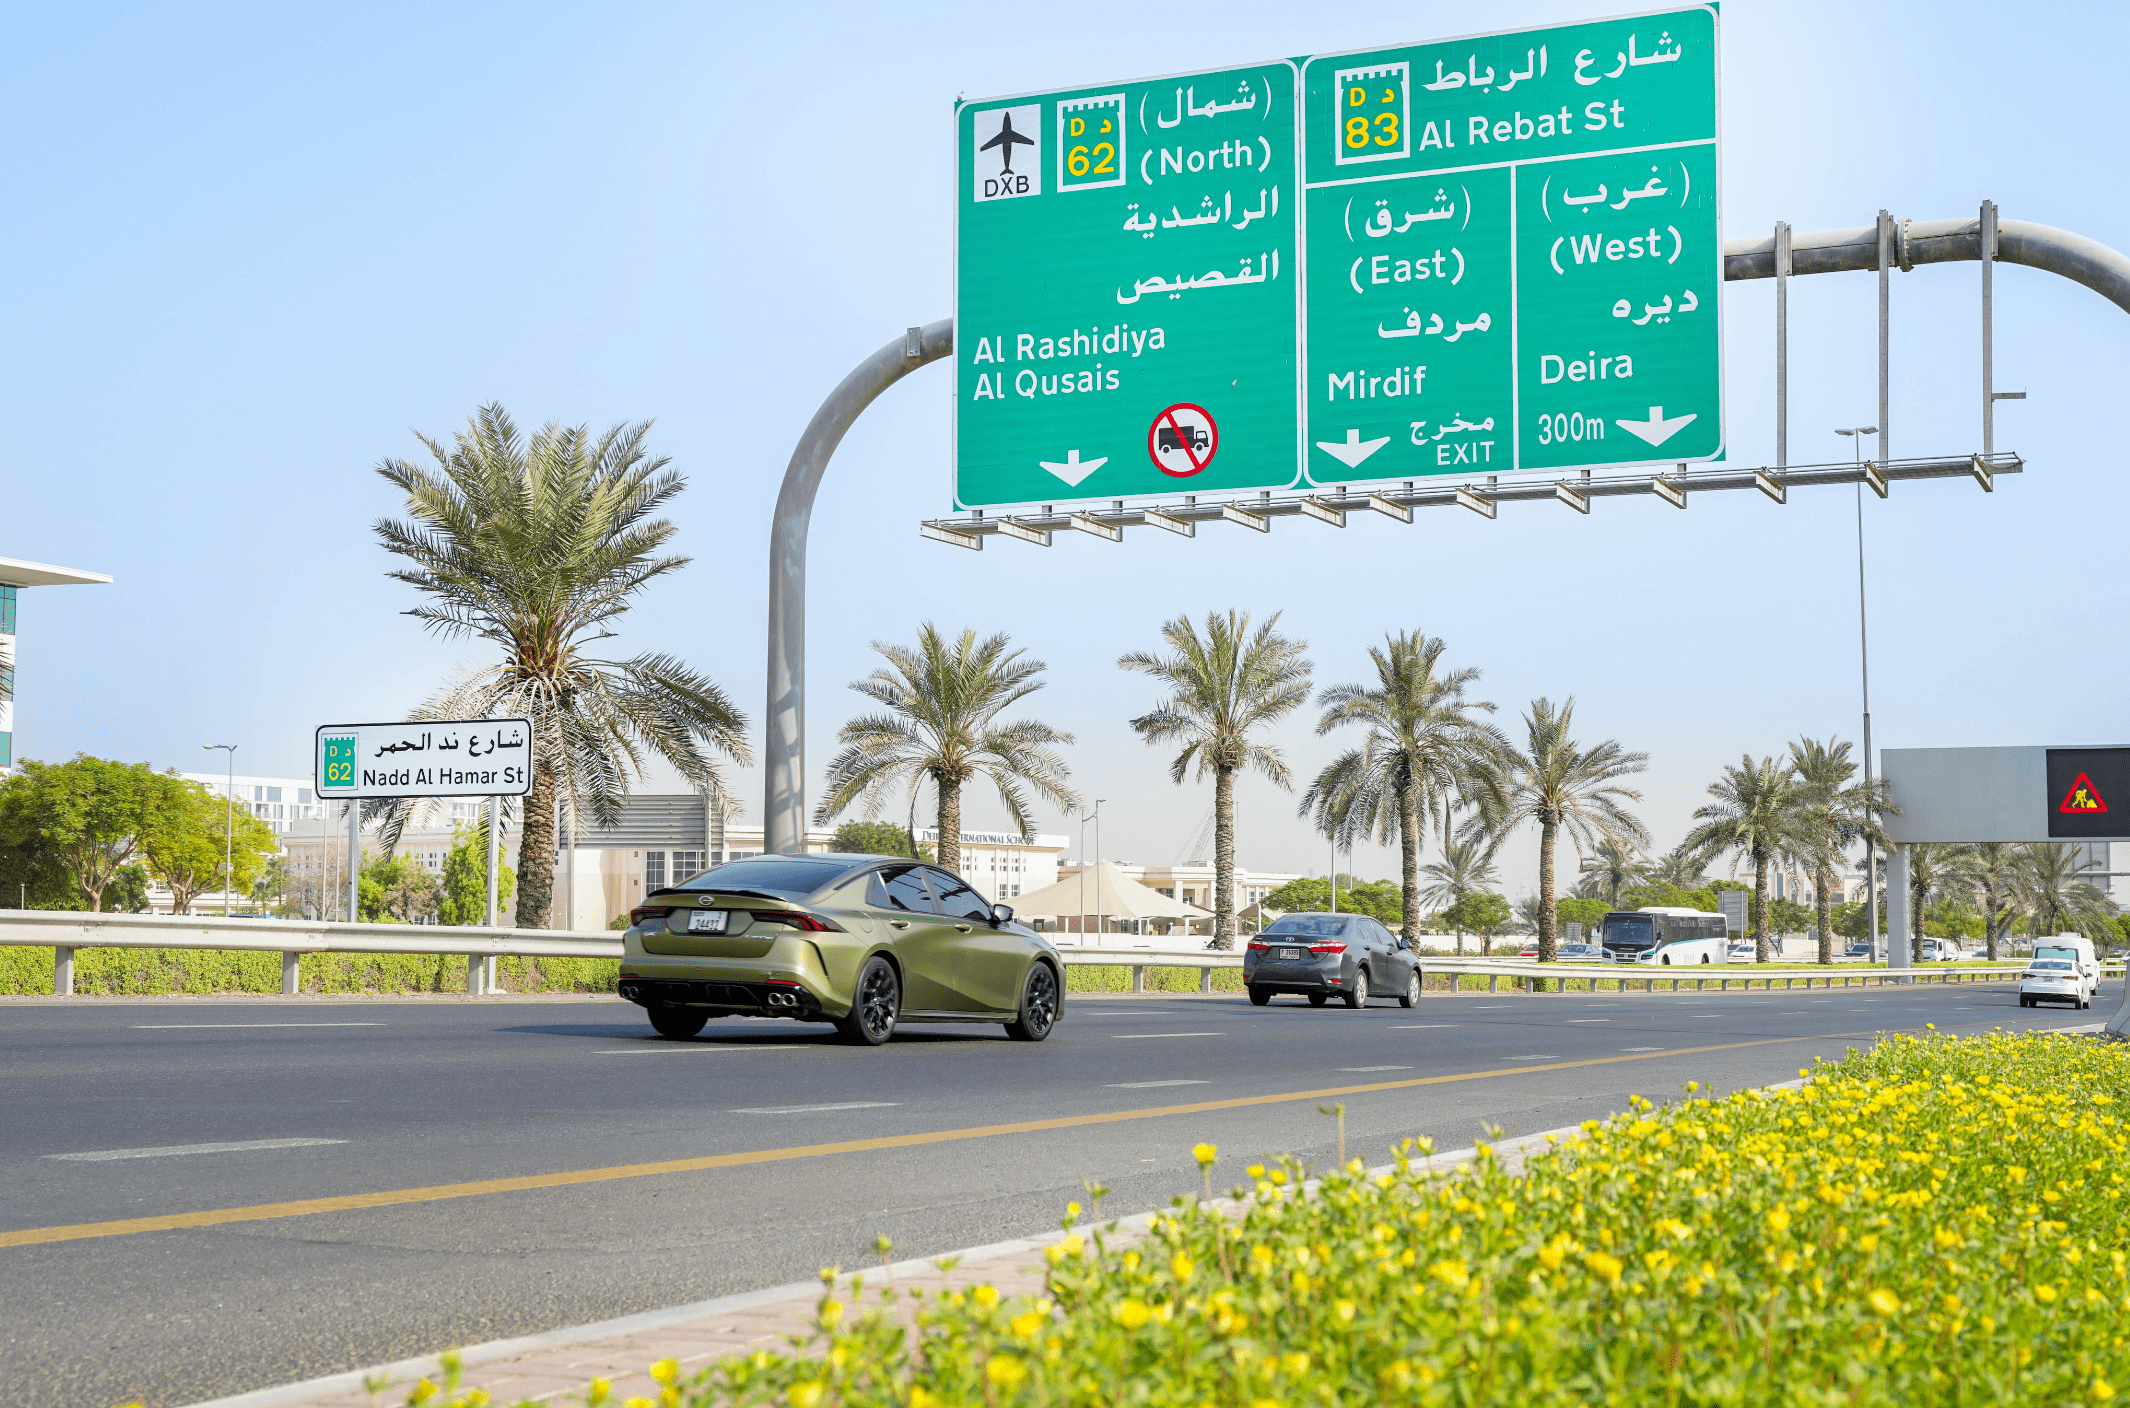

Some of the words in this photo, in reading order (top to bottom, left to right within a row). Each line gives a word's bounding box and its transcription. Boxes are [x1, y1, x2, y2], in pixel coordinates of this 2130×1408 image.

[1421, 43, 1548, 94] الرباط
[1573, 30, 1682, 86] شارع
[1349, 86, 1366, 107] D
[1381, 87, 1395, 104] د
[1070, 117, 1086, 137] D
[1099, 118, 1112, 134] د
[1345, 111, 1399, 149] 83
[1418, 119, 1455, 152] Al
[1468, 105, 1573, 146] Rebat
[1583, 98, 1625, 131] St
[1067, 141, 1115, 177] 62
[1140, 135, 1271, 186] (North)
[984, 175, 1030, 198] DXB
[1122, 184, 1279, 240] الراشدية
[1550, 224, 1682, 276] (West)
[1116, 247, 1279, 305] القصيص
[1350, 246, 1465, 295] (East)
[1377, 306, 1492, 343] مردف
[1612, 289, 1699, 326] ديره
[973, 335, 1006, 365] Al
[1017, 323, 1166, 361] Rashidiya
[973, 372, 1005, 401] Al
[1015, 362, 1120, 400] Qusais
[1328, 365, 1427, 402] Mirdif
[1540, 350, 1634, 385] Deira
[1409, 411, 1495, 446] مخرج
[1538, 411, 1605, 445] 300m
[1437, 440, 1495, 466] EXIT
[329, 745, 338, 757] D
[374, 731, 432, 758] الحمر
[438, 731, 459, 751] ند
[468, 729, 523, 758] شارع
[328, 762, 351, 781] 62
[363, 768, 410, 787] Nadd
[415, 768, 434, 785] Al
[439, 767, 498, 785] Hamar
[503, 766, 524, 784] St
